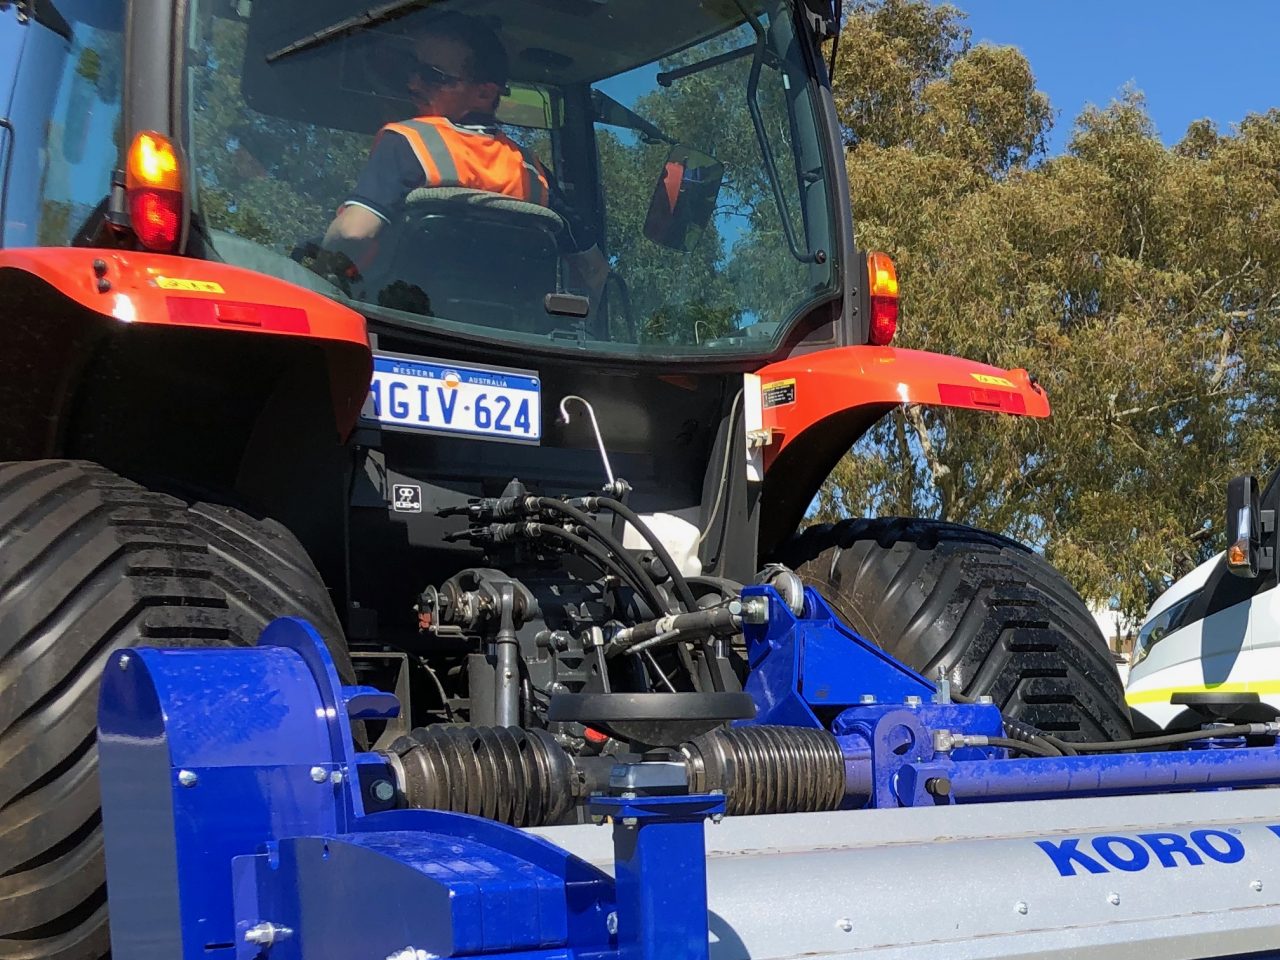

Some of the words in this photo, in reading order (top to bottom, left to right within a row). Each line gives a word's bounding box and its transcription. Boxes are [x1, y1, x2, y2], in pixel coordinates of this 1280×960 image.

[392, 366, 435, 378] WESTERN
[468, 376, 508, 388] AUSTRALIA
[1034, 829, 1245, 877] KORO
